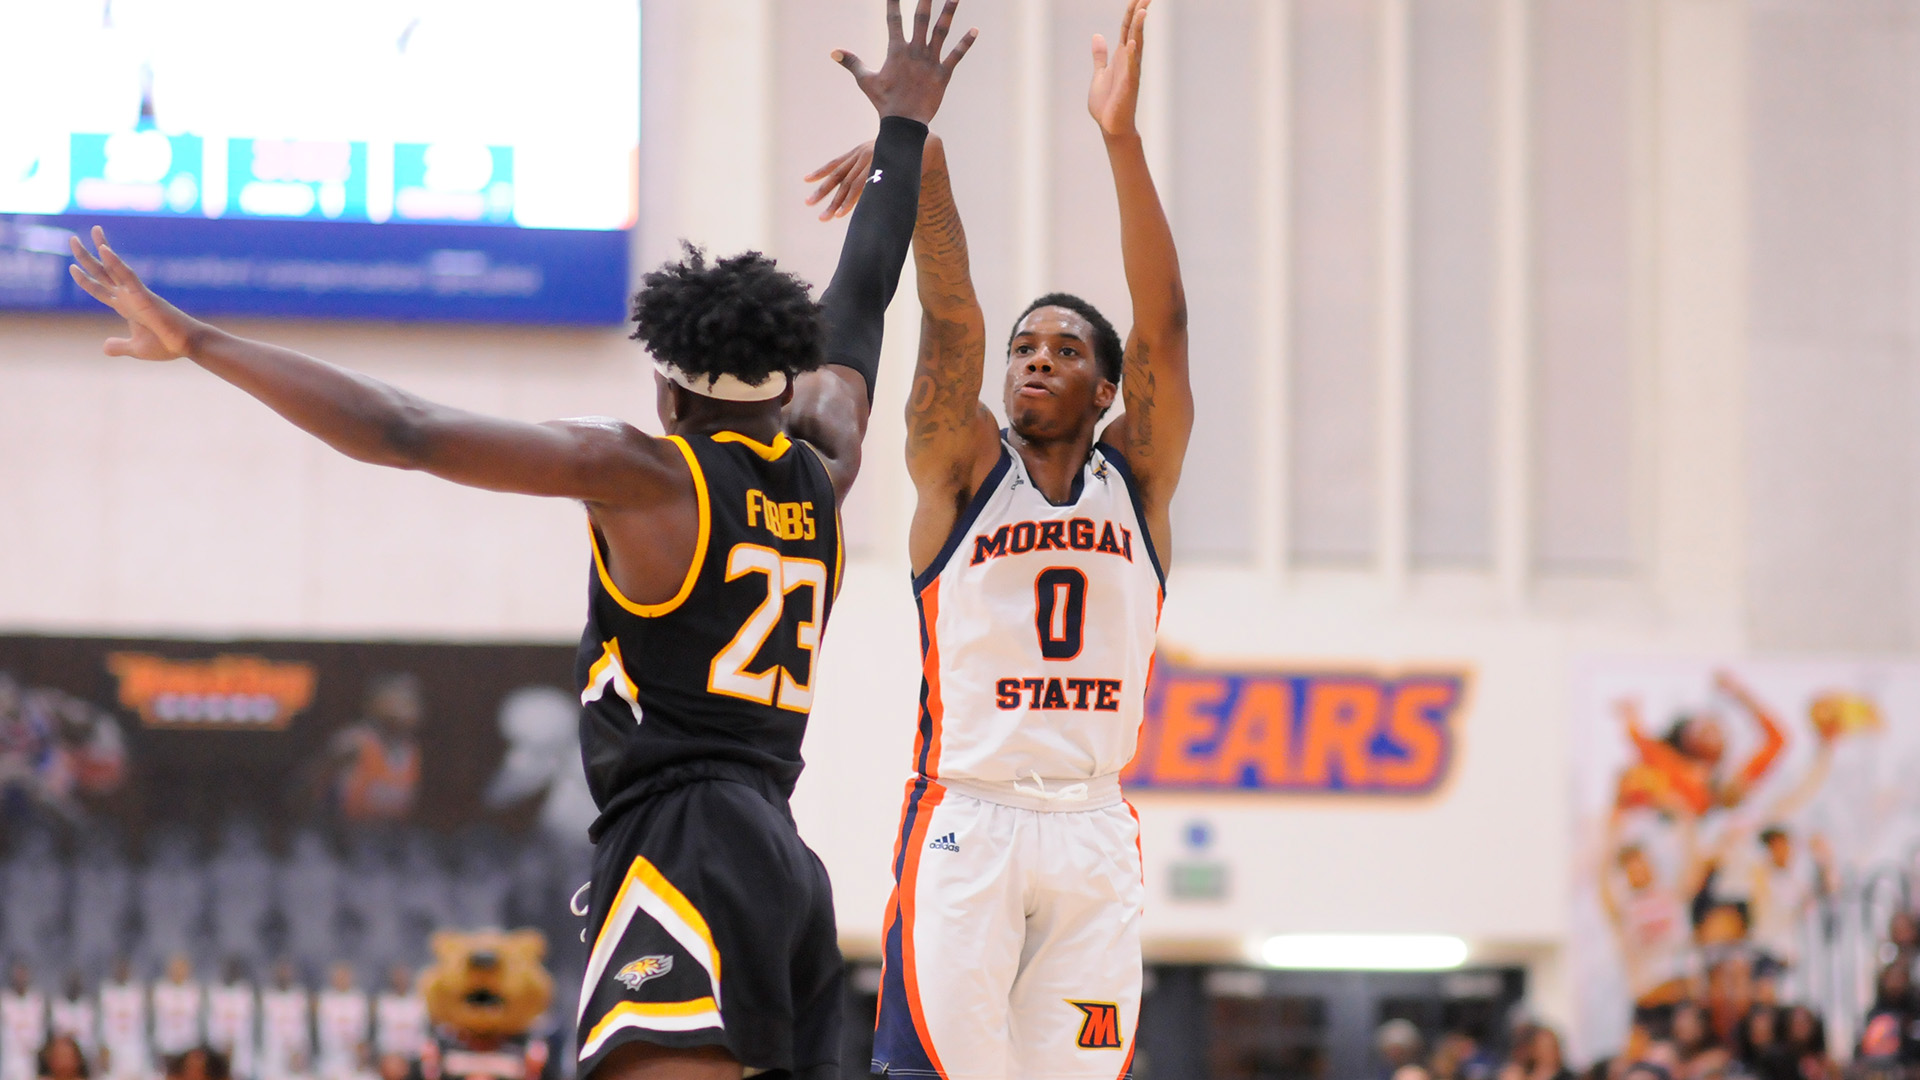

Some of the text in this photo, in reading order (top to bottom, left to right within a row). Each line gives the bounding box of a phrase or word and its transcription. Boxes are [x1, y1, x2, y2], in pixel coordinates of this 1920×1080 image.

[746, 488, 816, 540] FIBBS
[707, 542, 827, 714] 23
[1034, 565, 1088, 661] 0
[996, 677, 1122, 712] STATE
[1148, 674, 1456, 788] EARS
